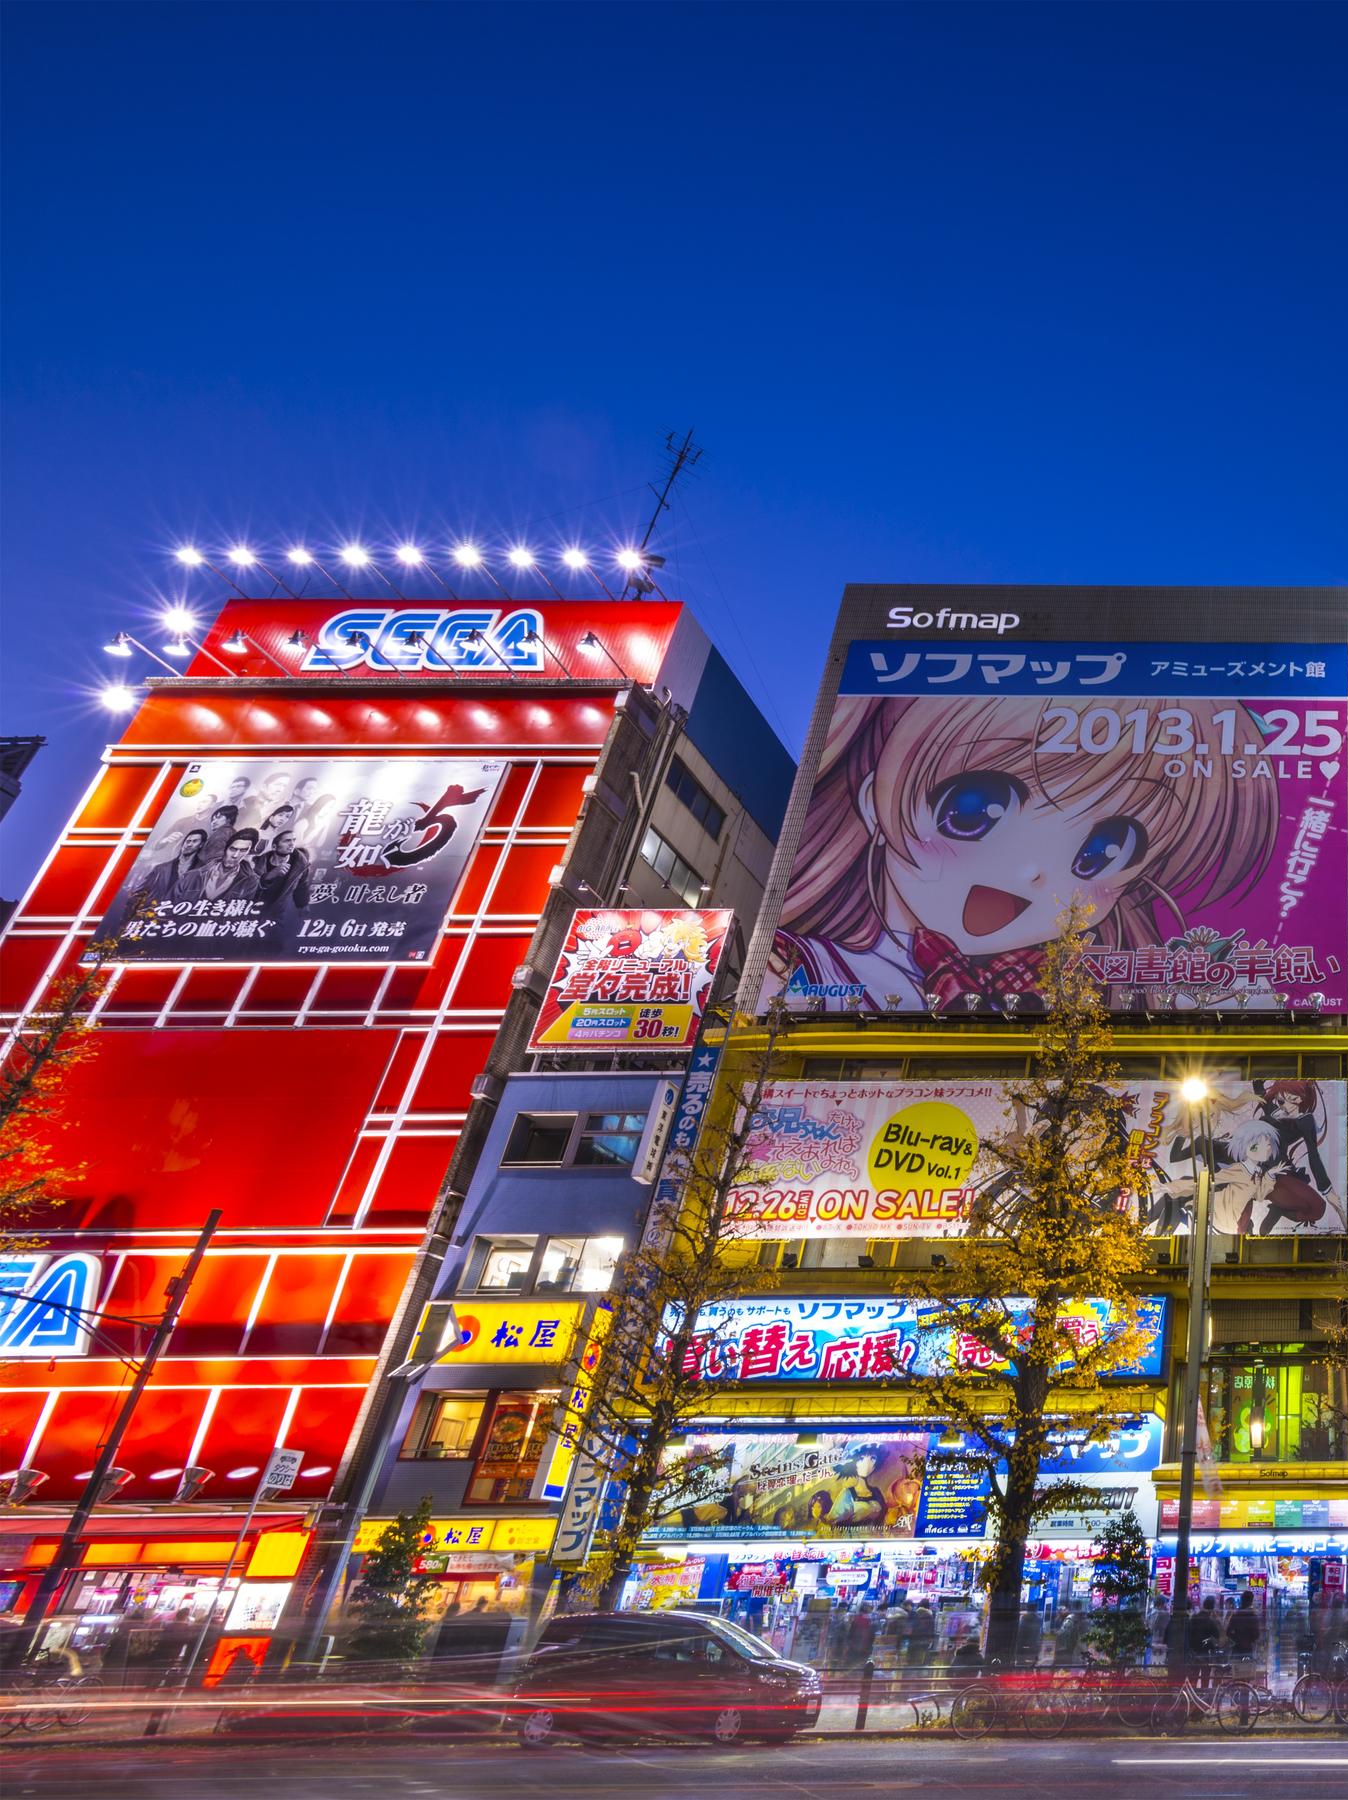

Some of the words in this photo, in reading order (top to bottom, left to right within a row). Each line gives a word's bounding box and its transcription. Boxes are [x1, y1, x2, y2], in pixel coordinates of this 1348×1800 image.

[887, 607, 1020, 634] Sofmap
[302, 609, 545, 671] SEGA
[870, 651, 1127, 684] ソフマップ
[1150, 660, 1327, 679] アミューズメント館
[1034, 707, 1342, 757] 2013.1.25
[1164, 760, 1214, 780] ON
[1231, 760, 1313, 780] SALE
[153, 900, 264, 917] その生き様に
[369, 920, 408, 938] 発売
[298, 944, 390, 955] ryu-ga-gotoku.com
[558, 973, 693, 1002] 堂々完成!
[806, 982, 867, 998] AUGUST
[633, 1019, 679, 1039] 30秒!
[873, 1148, 926, 1174] DVD
[927, 1163, 961, 1180] Vol.1
[815, 1188, 869, 1220] ON
[873, 1188, 976, 1219] SALE!
[746, 1305, 791, 1316] サポートも
[798, 1301, 909, 1320] ソフマップ
[490, 1320, 561, 1348] 松屋
[560, 1387, 588, 1449] 松屋
[273, 1463, 296, 1473] タクシー
[1259, 1469, 1289, 1479] Sofmap
[268, 1473, 294, 1487] のりば
[444, 1526, 485, 1545] 松屋
